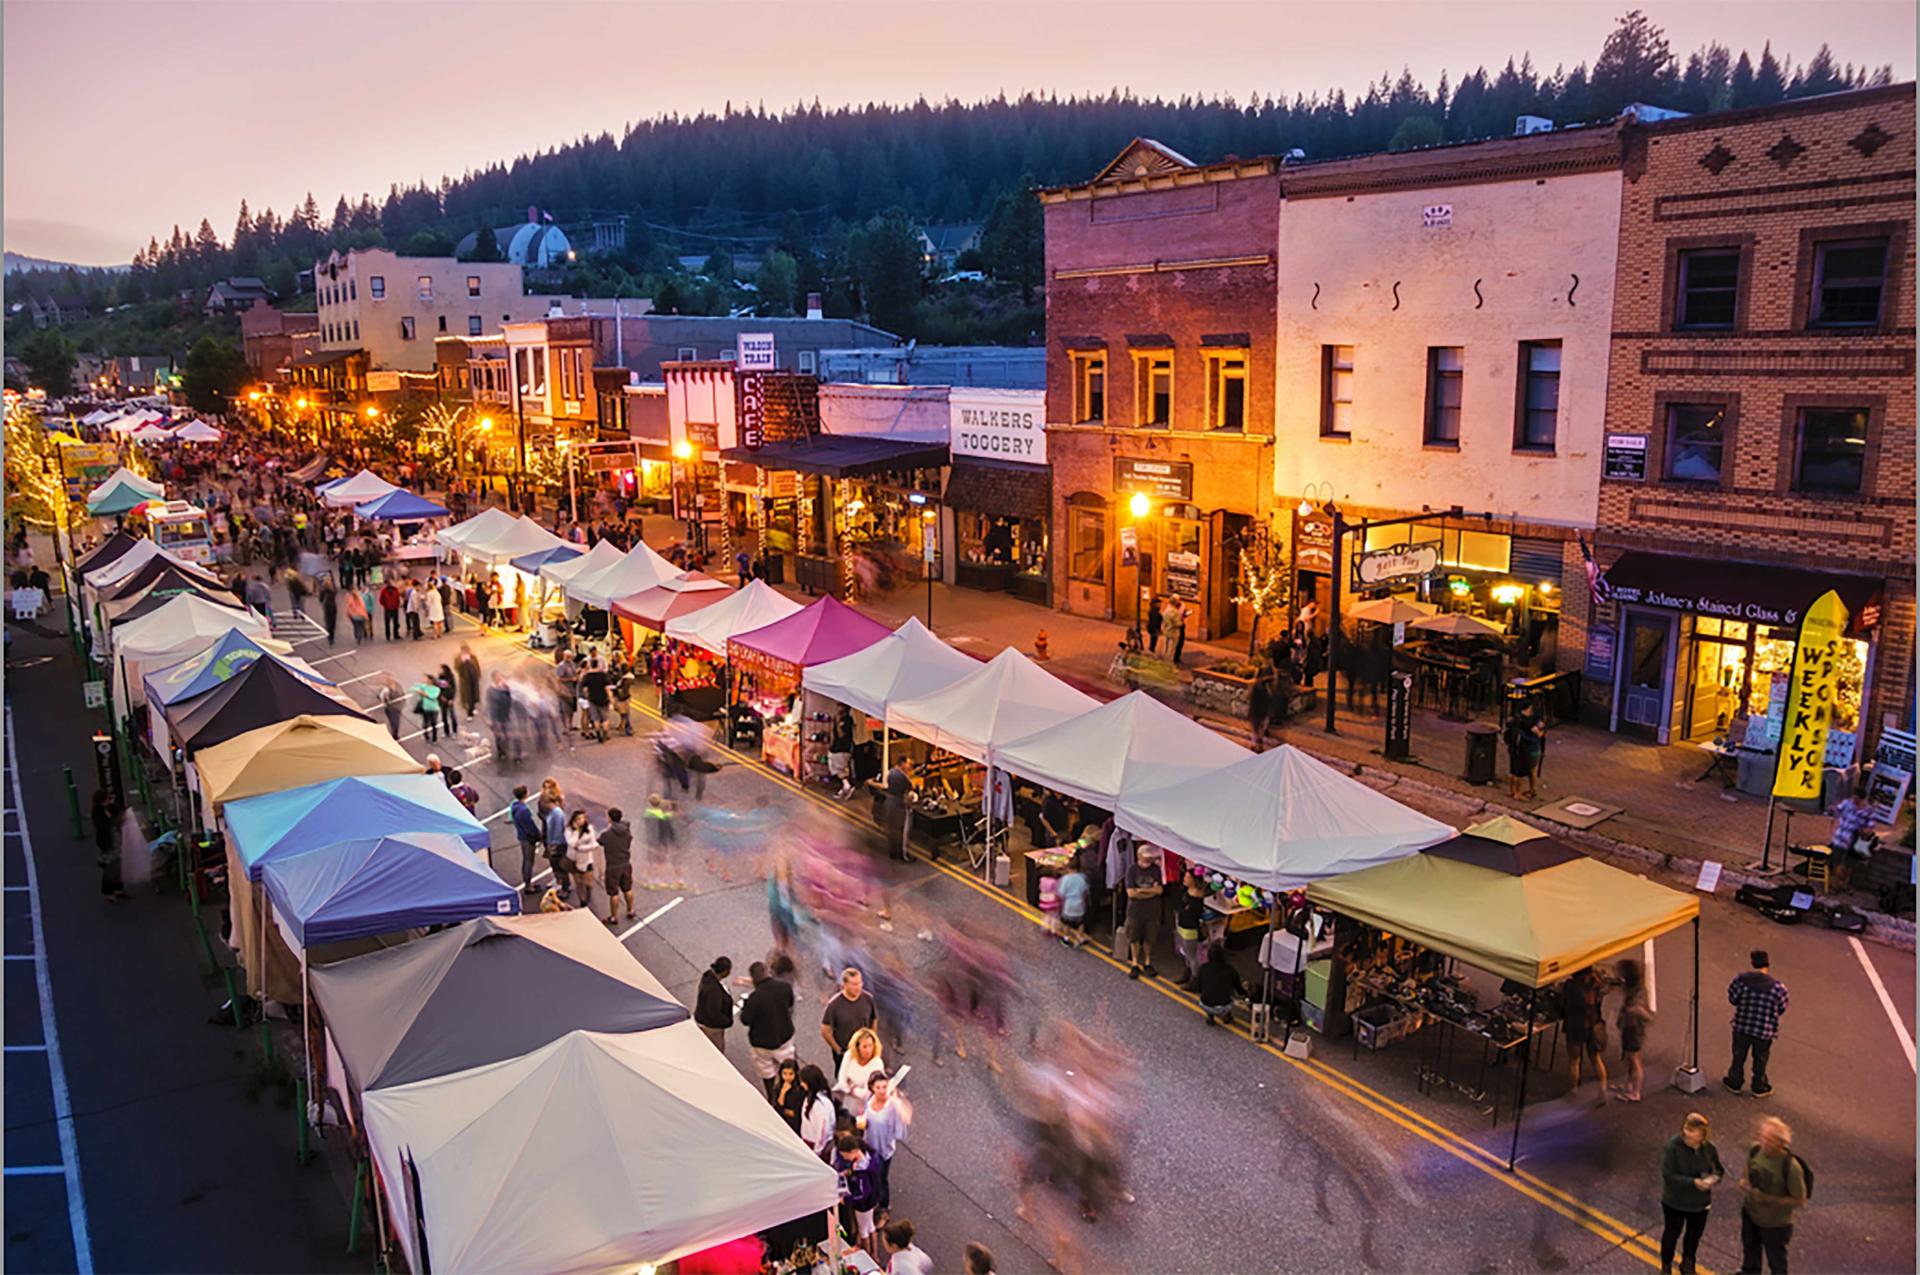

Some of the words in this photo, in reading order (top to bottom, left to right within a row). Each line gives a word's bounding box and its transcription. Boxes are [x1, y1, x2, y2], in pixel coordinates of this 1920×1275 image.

[743, 341, 772, 352] WAGON
[744, 353, 771, 364] TRAIN
[743, 378, 757, 446] CAFE
[961, 410, 1034, 430] WALKERS
[961, 433, 1034, 455] TOGGERY
[1696, 597, 1742, 616] Stained
[1745, 603, 1780, 621] Glass
[1789, 646, 1824, 771] WEEKLY
